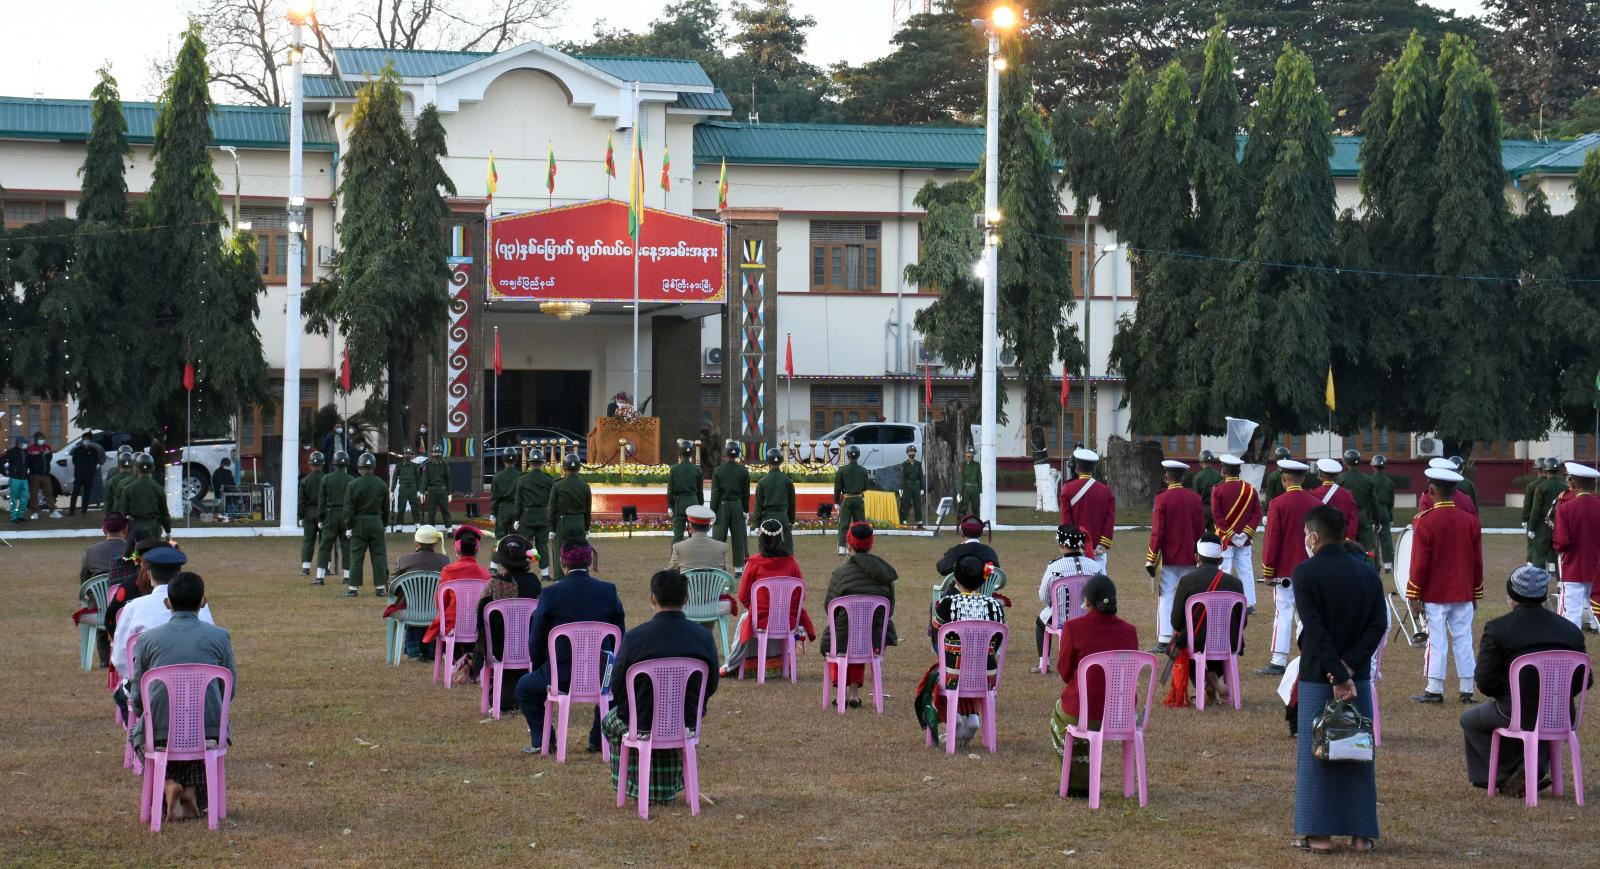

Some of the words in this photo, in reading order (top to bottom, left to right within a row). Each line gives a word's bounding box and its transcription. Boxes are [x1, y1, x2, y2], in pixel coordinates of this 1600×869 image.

[576, 239, 718, 263] လွတ်လပ်ေးနေ့အခမ်းအနား
